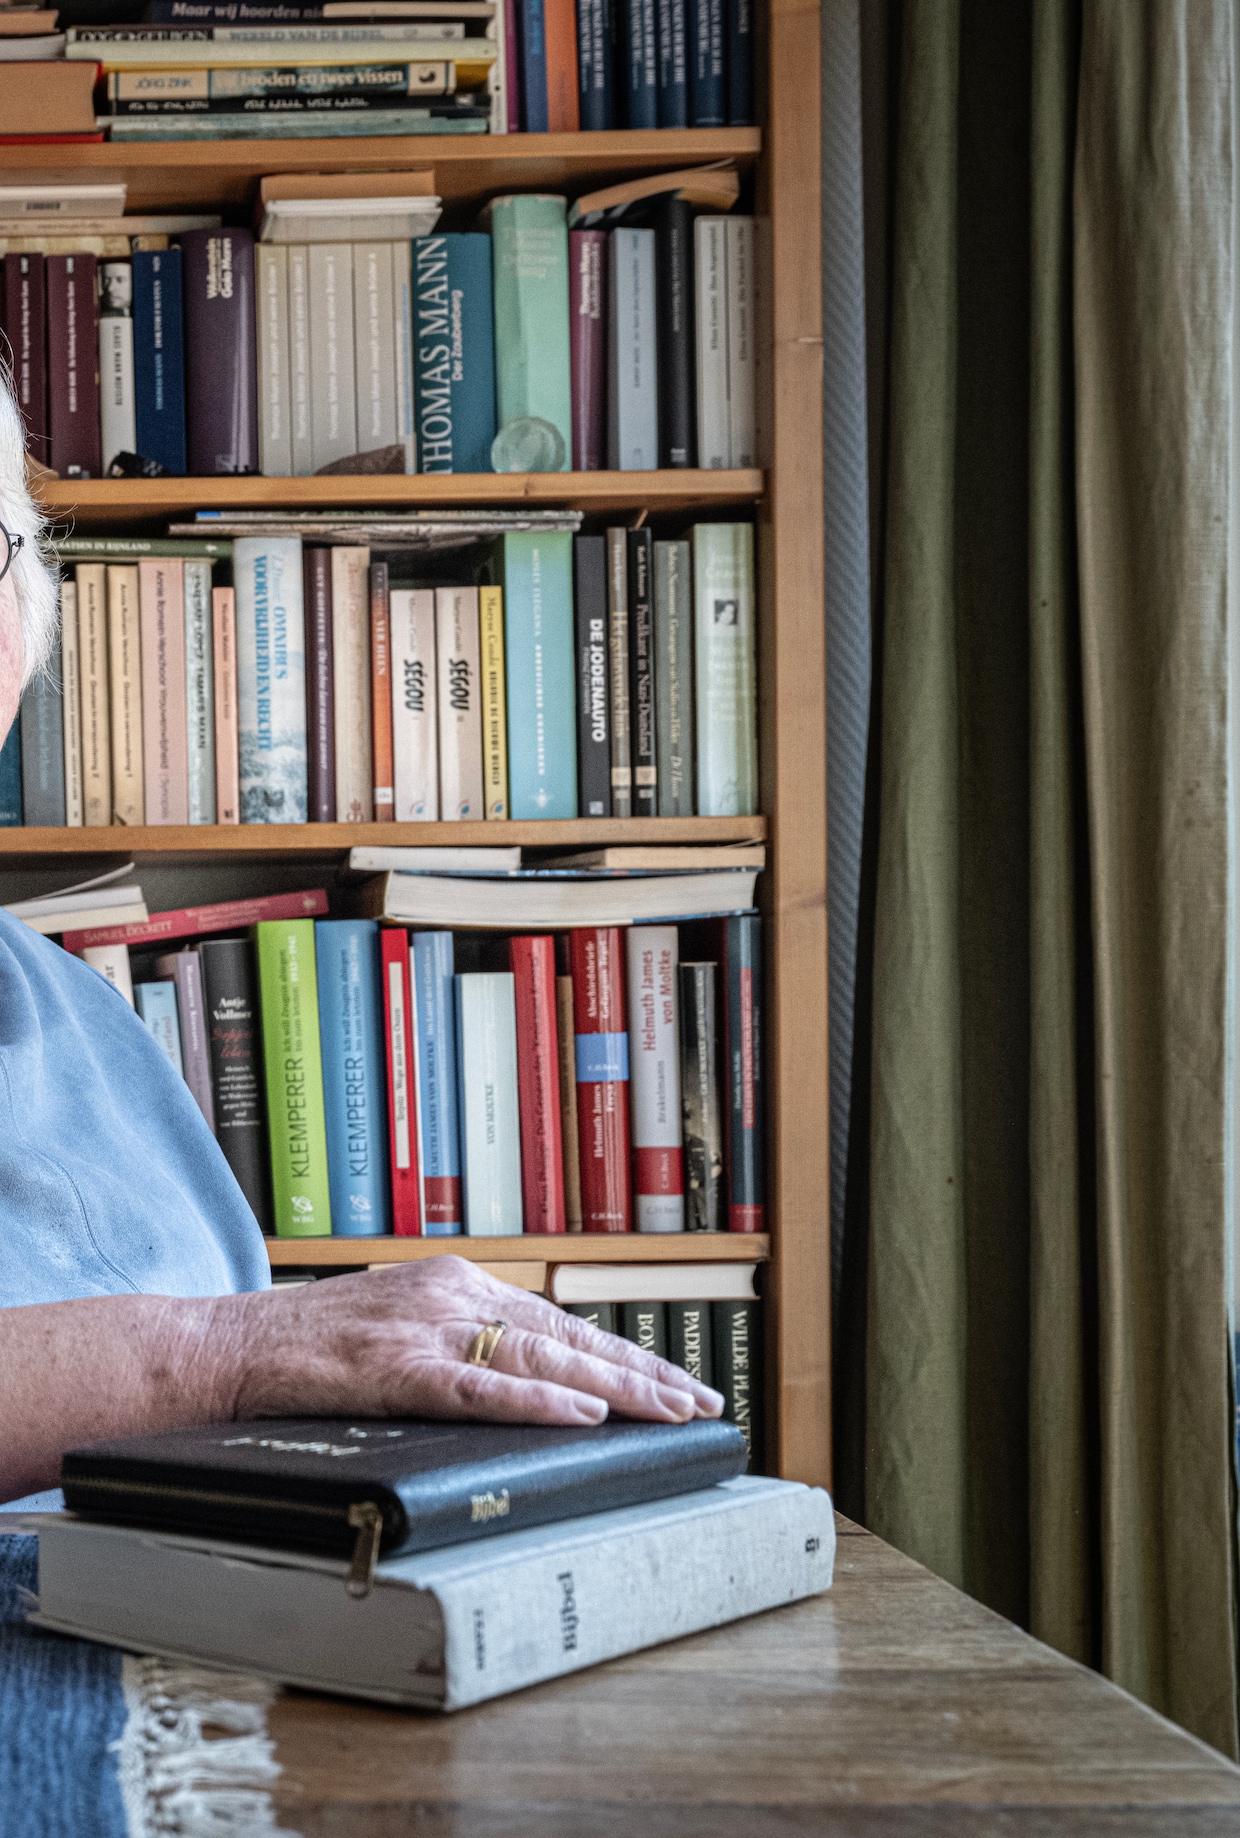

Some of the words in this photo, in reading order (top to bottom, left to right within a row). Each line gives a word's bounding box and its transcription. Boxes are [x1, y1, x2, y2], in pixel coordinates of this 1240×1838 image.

[171, 2, 212, 18] Maar
[214, 3, 237, 20] wij
[239, 3, 301, 18] hoorden
[357, 69, 404, 85] vissen
[416, 237, 451, 338] MANN
[450, 289, 464, 358] Zauberberg
[451, 360, 464, 381] Der
[419, 344, 452, 474] THOMAS
[155, 570, 167, 597] Annie
[252, 554, 267, 599] VOOR
[485, 596, 498, 632] Maryse
[590, 619, 603, 641] DE
[613, 611, 628, 636] Het
[636, 604, 650, 656] Predikant
[254, 600, 269, 673] VRIJHEID
[273, 606, 288, 680] OMNIBUS
[487, 634, 500, 666] Condé
[256, 674, 270, 696] EN
[404, 659, 428, 713] SÉGOU
[448, 658, 474, 712] SÉGOU
[638, 659, 650, 671] in
[591, 644, 606, 742] JODENAUTO
[257, 698, 271, 751] RECHT
[638, 674, 652, 756] Nazi-Duitsland
[671, 755, 682, 767] De
[640, 949, 655, 991] James
[658, 949, 672, 997] Moltke
[641, 993, 657, 1051] Helmuth
[661, 999, 673, 1025] von
[425, 1041, 436, 1078] MOLTKE
[426, 1081, 436, 1100] VON
[484, 1083, 494, 1122] MOLTKE
[591, 1085, 603, 1114] James
[655, 1060, 666, 1124] Brakelmann
[284, 1058, 310, 1179] KLEMPERER
[345, 1057, 368, 1177] KLEMPERER
[427, 1104, 437, 1133] JAMES
[485, 1124, 496, 1146] VON
[428, 1136, 439, 1177] ELMUTH
[683, 1312, 701, 1384] PADDES
[732, 1310, 749, 1370] WILDE
[733, 1374, 752, 1457] PLANT
[471, 1487, 510, 1524] Bijbel
